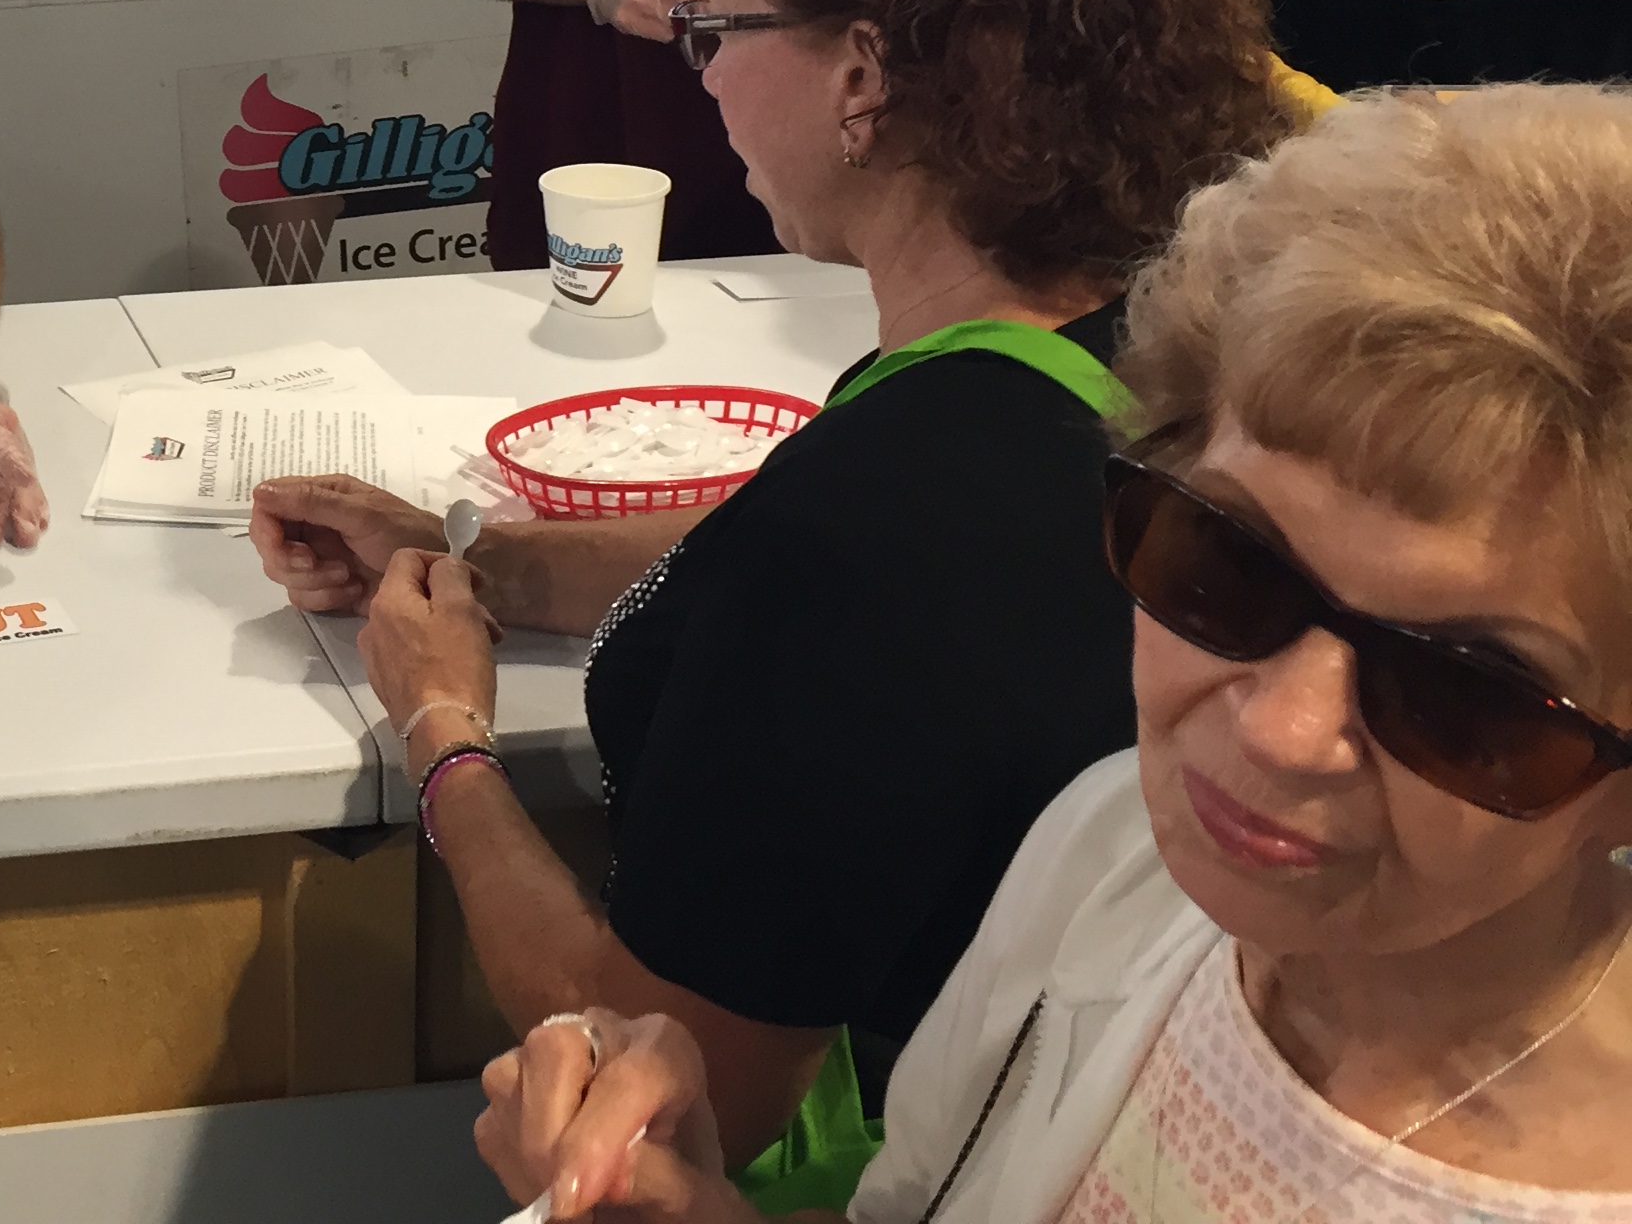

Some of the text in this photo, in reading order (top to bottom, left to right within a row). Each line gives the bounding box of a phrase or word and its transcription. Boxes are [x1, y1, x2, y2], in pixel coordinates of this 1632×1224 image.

[339, 238, 397, 273] Ice
[226, 367, 328, 390] ISCLAIMER
[198, 409, 222, 498] PRODUCT DISCLAIMER
[14, 626, 63, 639] Cream
